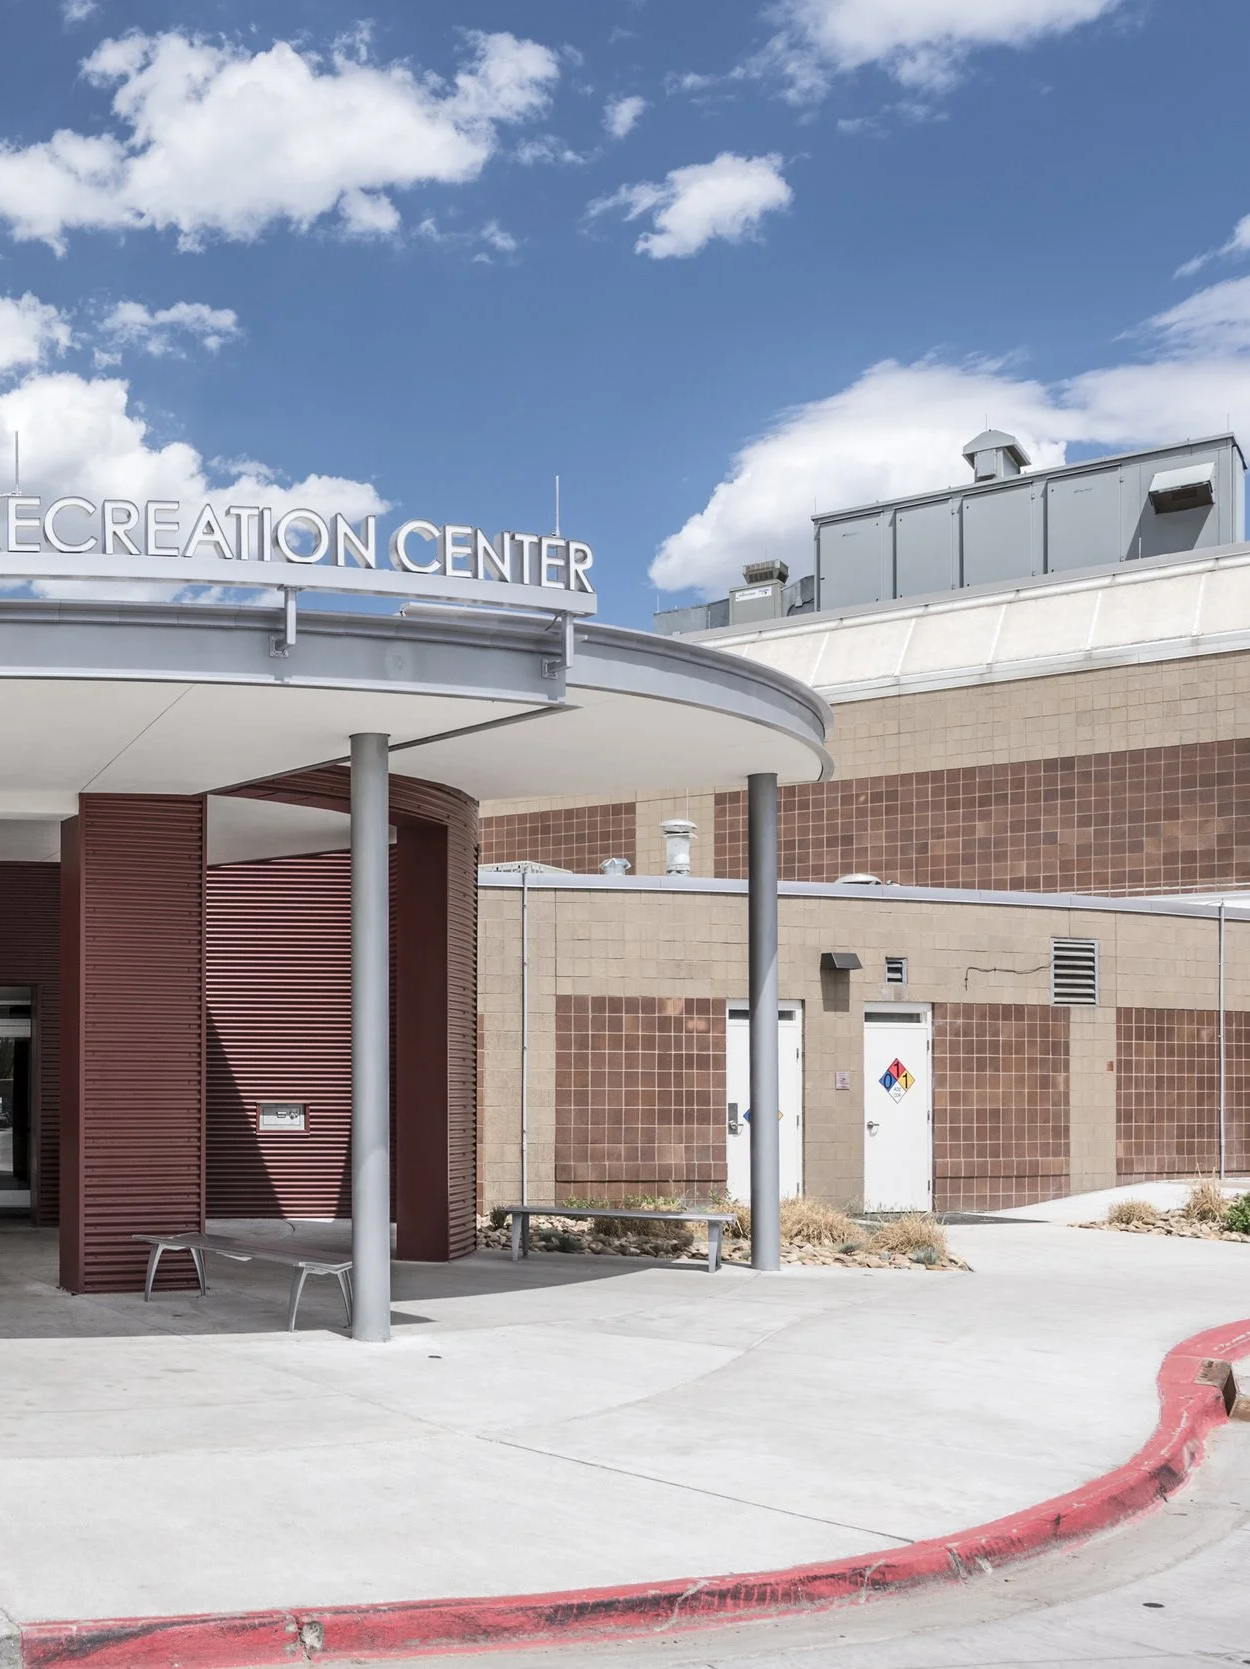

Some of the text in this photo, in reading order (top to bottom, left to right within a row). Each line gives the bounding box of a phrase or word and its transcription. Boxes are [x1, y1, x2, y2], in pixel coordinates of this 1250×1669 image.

[390, 519, 595, 594] CENTER
[894, 1061, 900, 1078] 1
[883, 1073, 892, 1090] 0
[902, 1072, 908, 1089] 1
